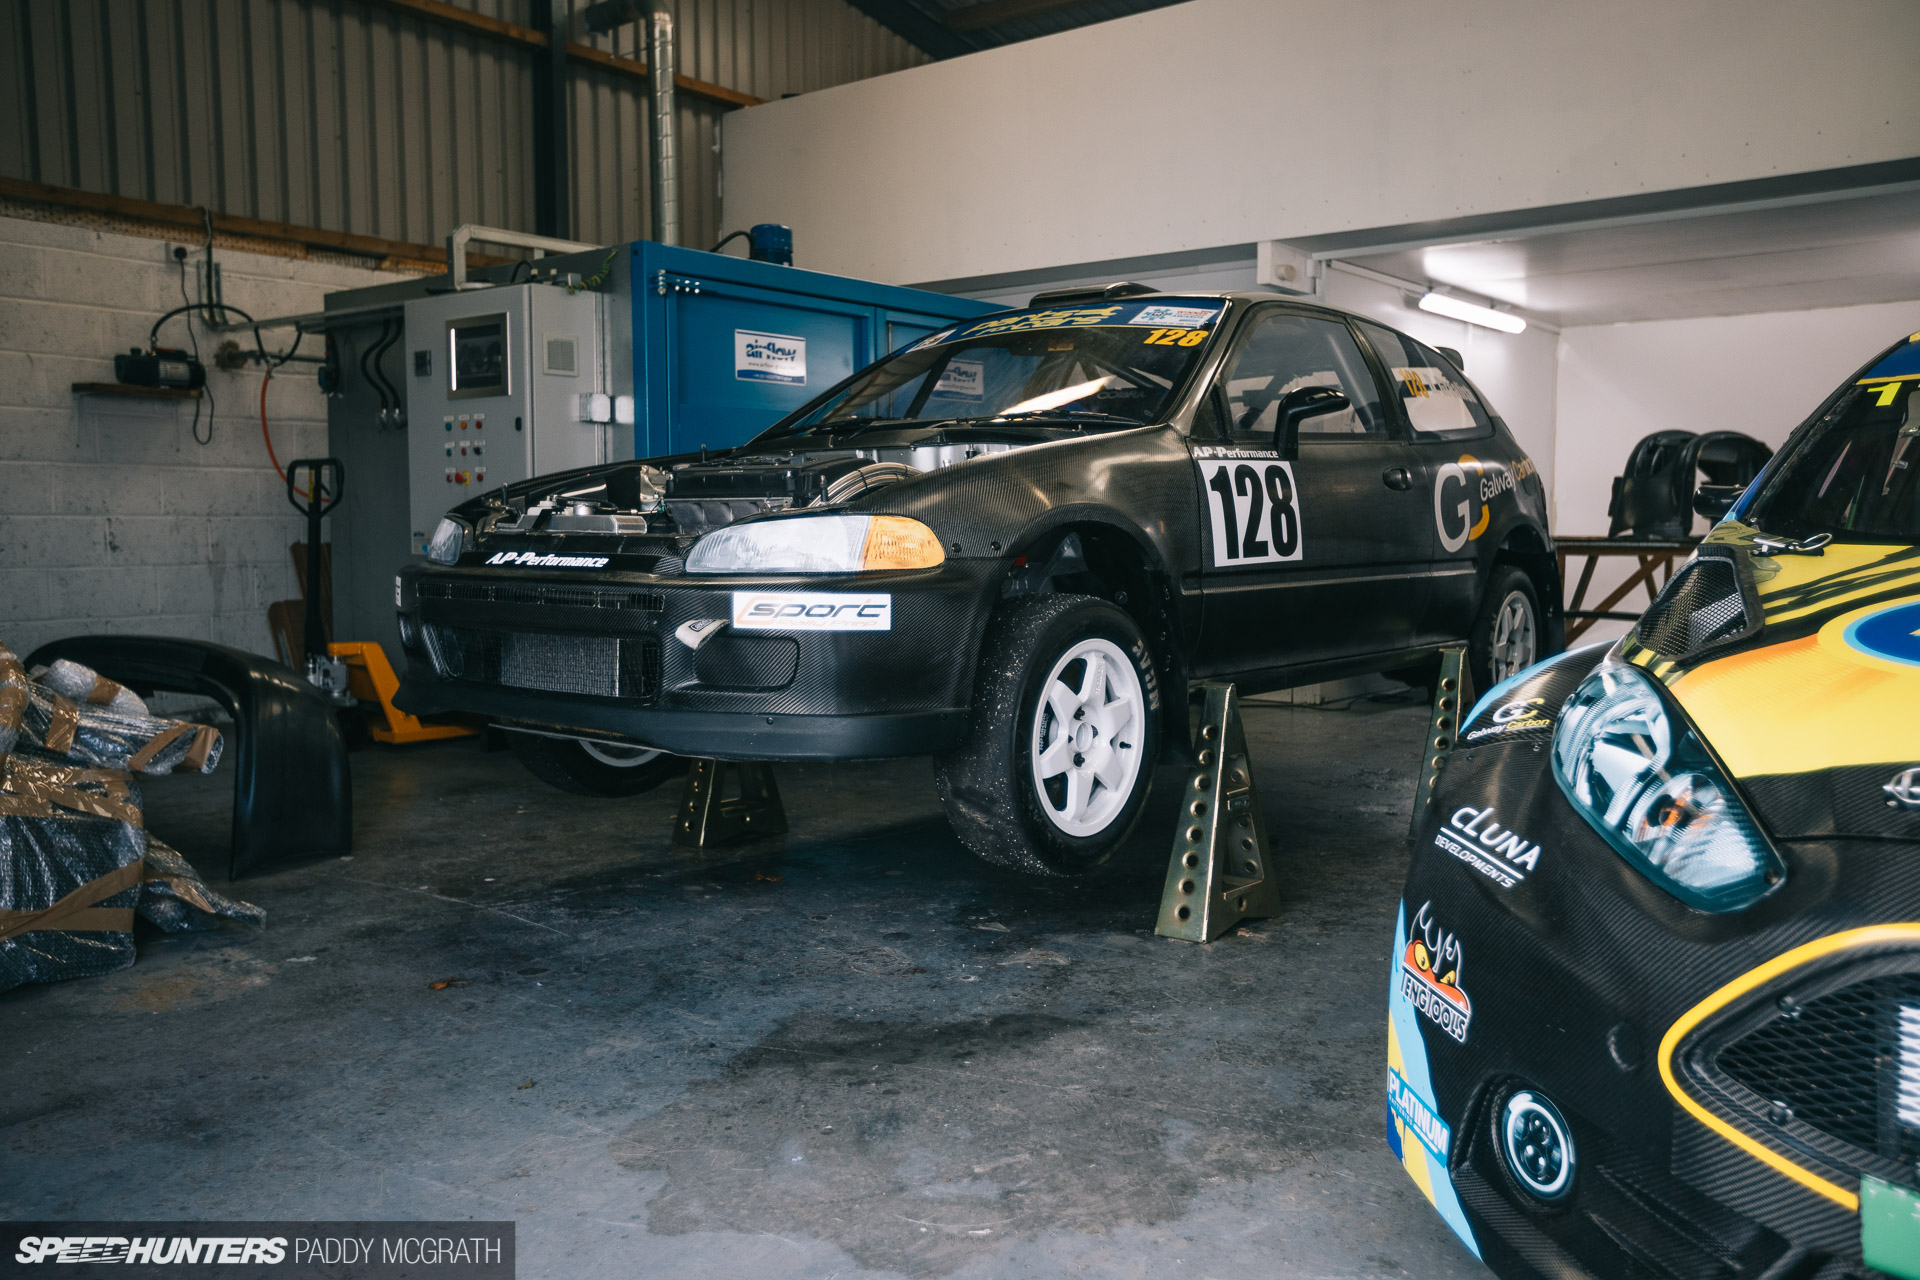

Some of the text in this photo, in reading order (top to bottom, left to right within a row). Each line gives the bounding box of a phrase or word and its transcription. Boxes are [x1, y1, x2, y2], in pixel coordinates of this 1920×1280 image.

[746, 339, 797, 362] airflow
[1143, 328, 1210, 347] 128
[1399, 368, 1430, 399] 128
[1480, 456, 1536, 502] Galway Carbo
[1209, 463, 1299, 560] 128
[1467, 719, 1551, 740] Galway Carbon
[1434, 834, 1517, 889] DEVELOPMENTS
[1388, 1069, 1449, 1155] PLATINUM
